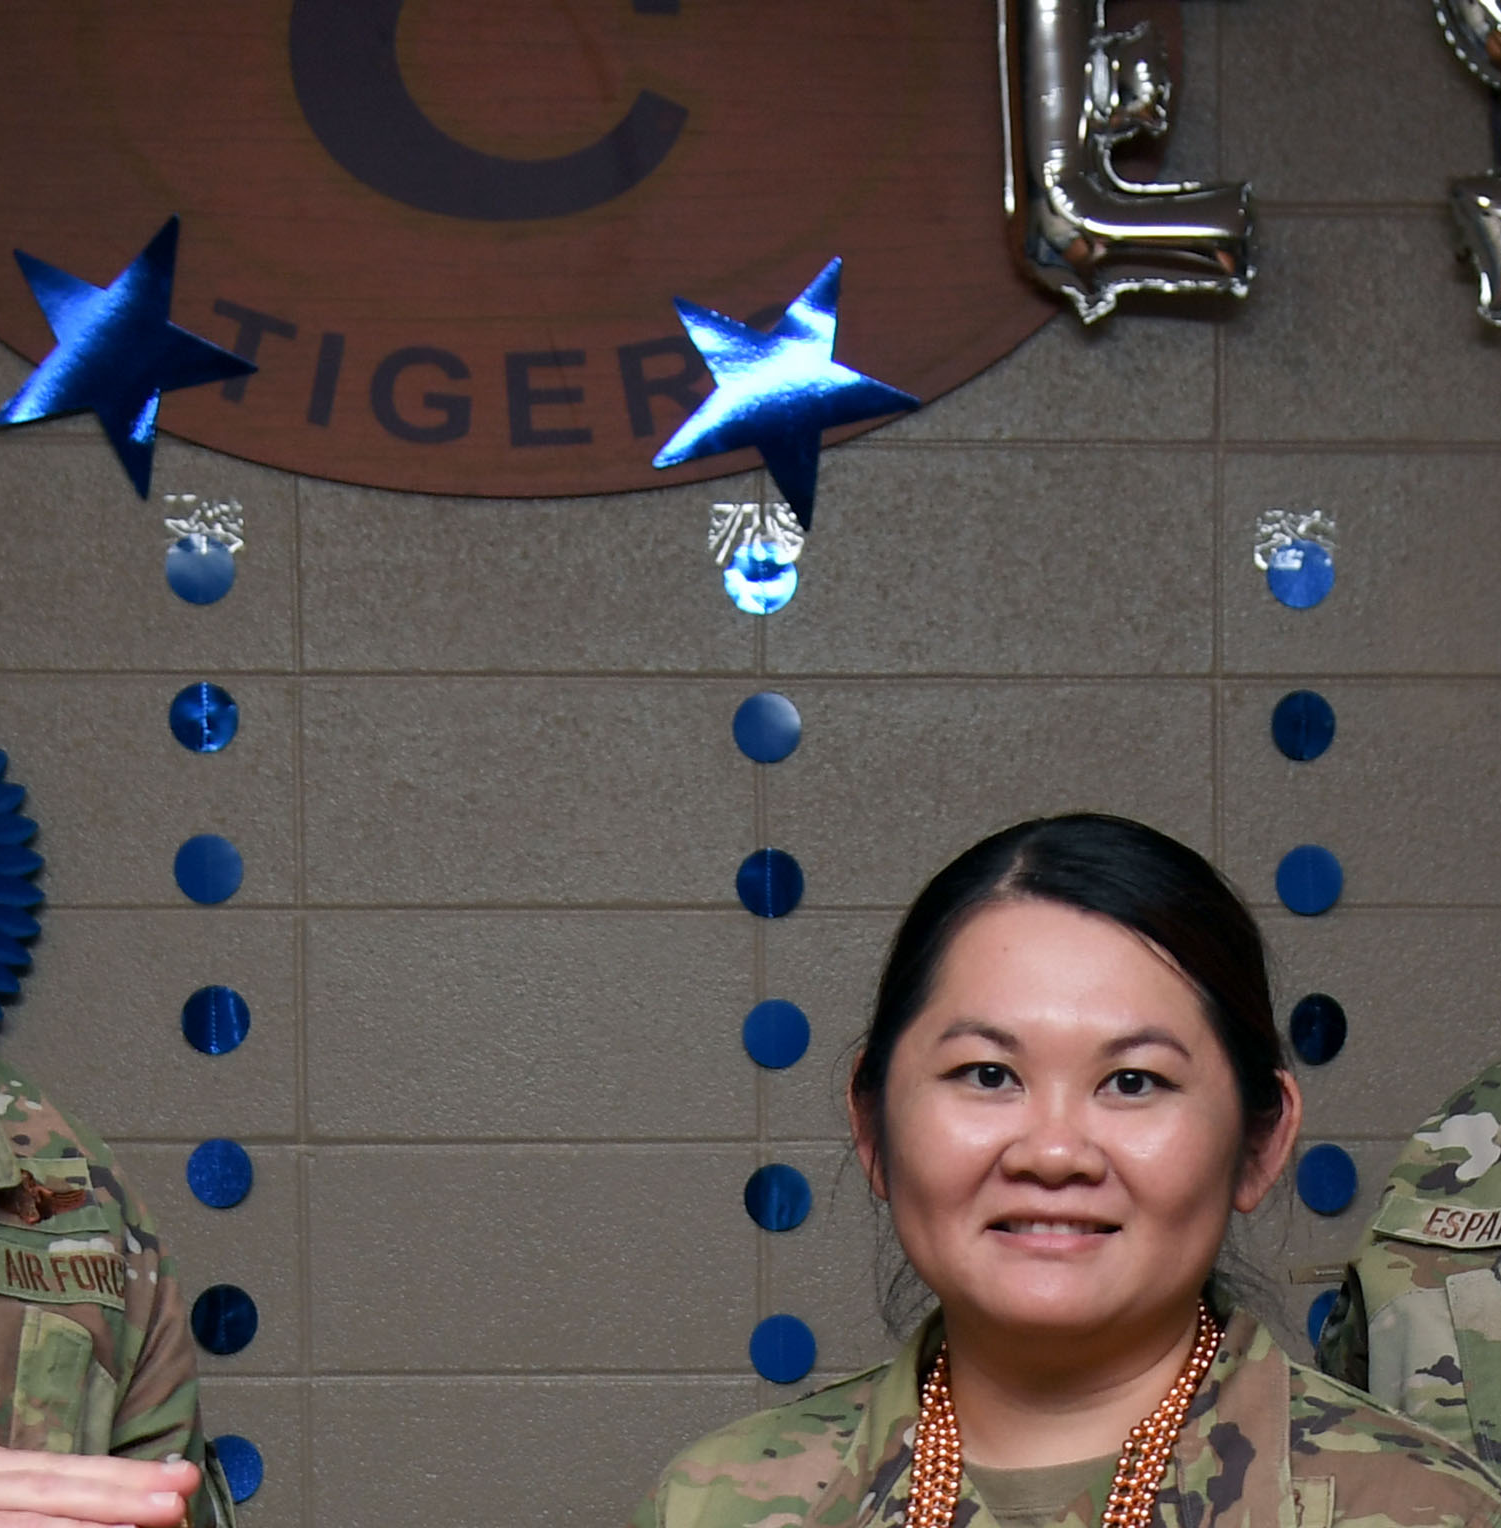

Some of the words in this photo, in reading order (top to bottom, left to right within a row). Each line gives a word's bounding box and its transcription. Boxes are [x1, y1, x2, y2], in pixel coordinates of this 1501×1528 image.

[210, 298, 784, 447] TIGER
[5, 1248, 50, 1291] AIR
[50, 1254, 125, 1298] FORC
